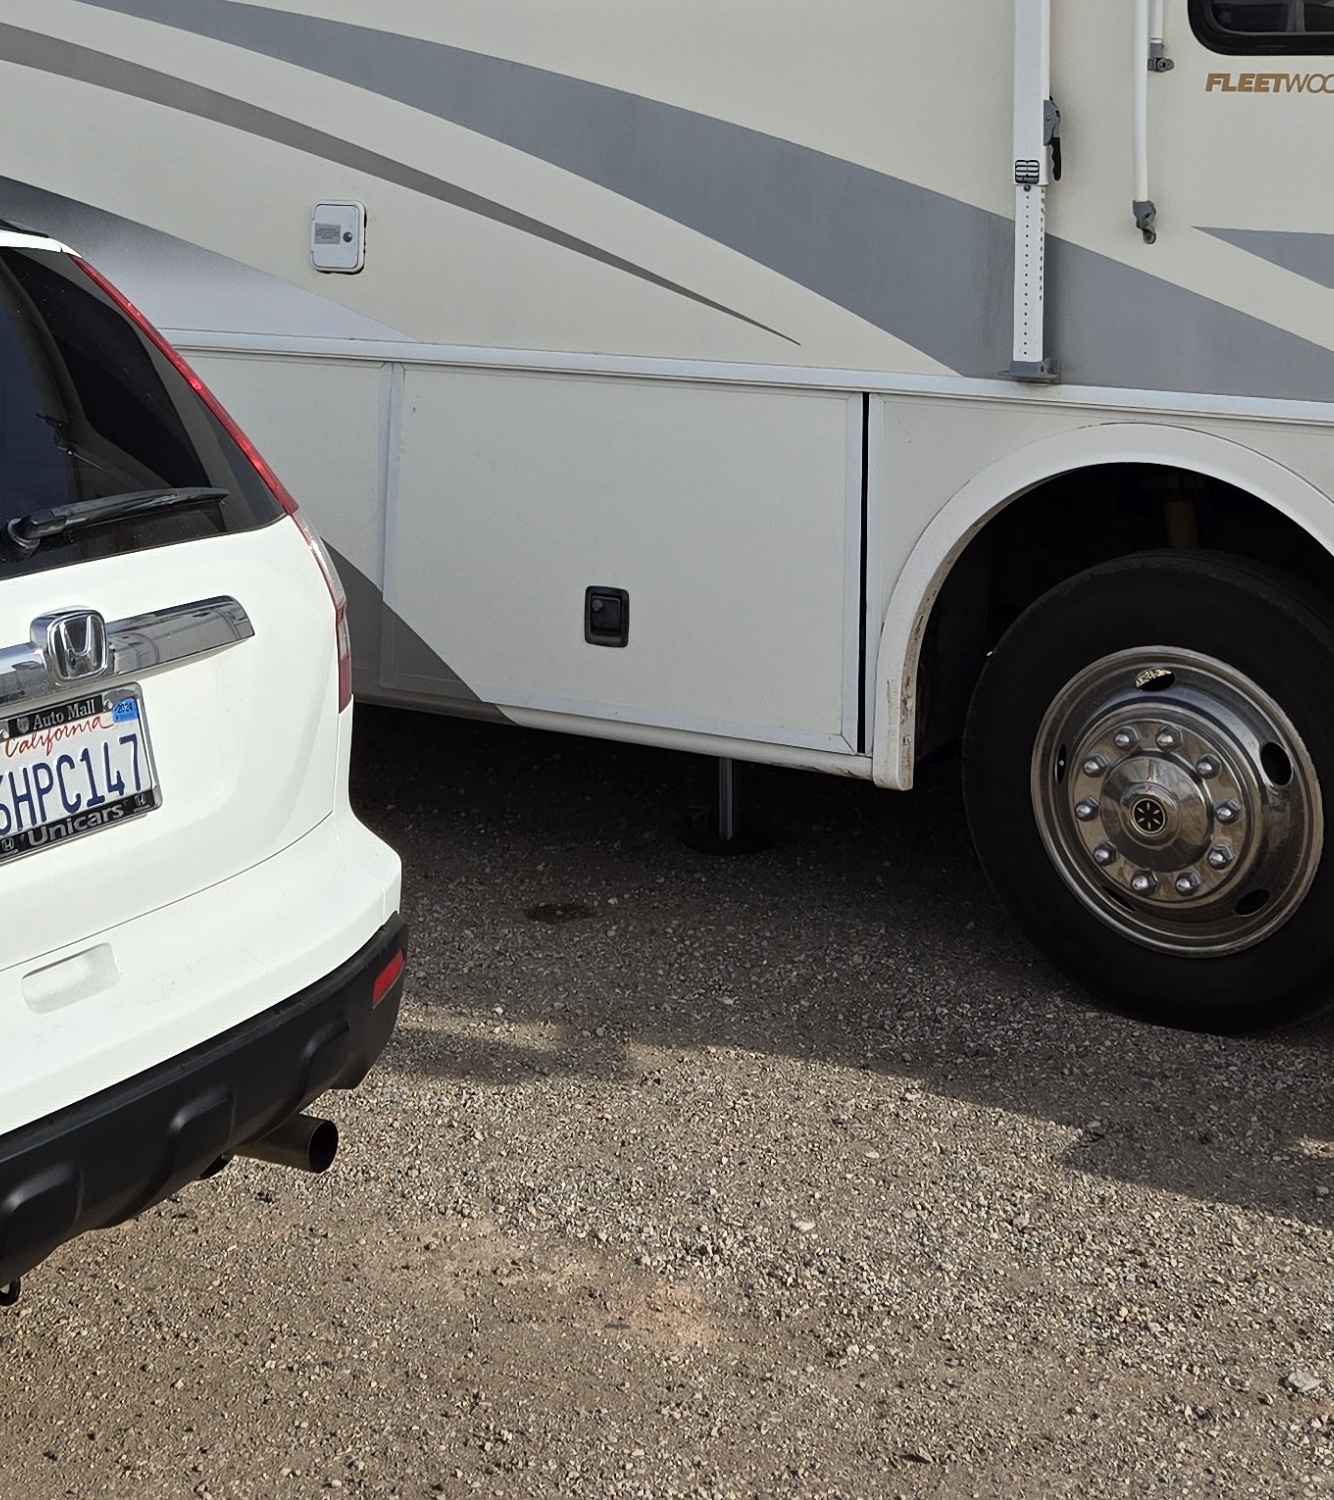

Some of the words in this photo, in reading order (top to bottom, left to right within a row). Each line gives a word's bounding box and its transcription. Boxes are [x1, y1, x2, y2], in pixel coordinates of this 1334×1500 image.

[33, 710, 64, 731] Auto
[67, 699, 95, 720] Mall
[5, 716, 114, 758] California
[27, 803, 125, 847] Unicars
